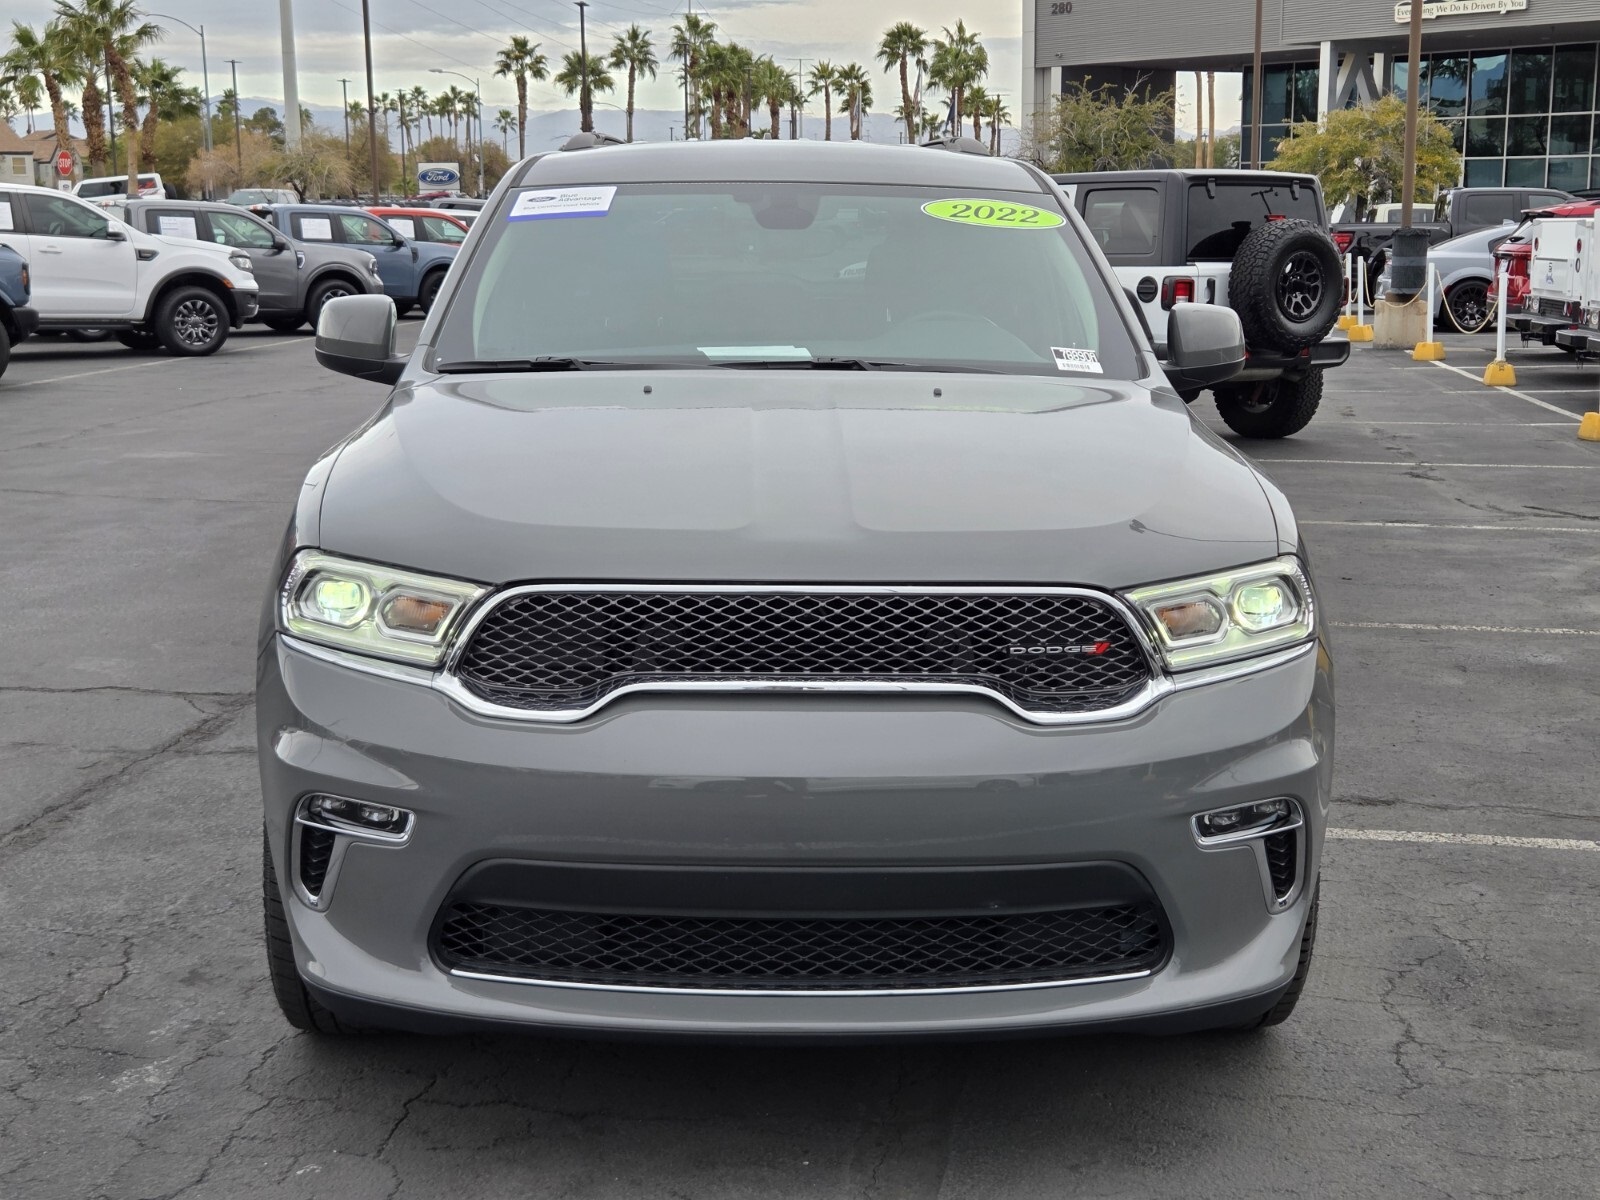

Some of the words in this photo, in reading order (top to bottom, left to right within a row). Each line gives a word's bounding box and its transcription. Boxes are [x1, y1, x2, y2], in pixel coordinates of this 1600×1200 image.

[1051, 1, 1073, 16] 280
[1397, 5, 1434, 16] Evering
[1436, 5, 1448, 13] We
[1450, 4, 1461, 12] Do
[1471, 2, 1496, 11] Driven
[1498, 0, 1508, 9] By
[1510, 0, 1524, 8] You
[59, 158, 71, 168] STOP
[426, 170, 450, 182] Ford
[949, 203, 1040, 224] 2022
[1009, 645, 1097, 655] DODGE
